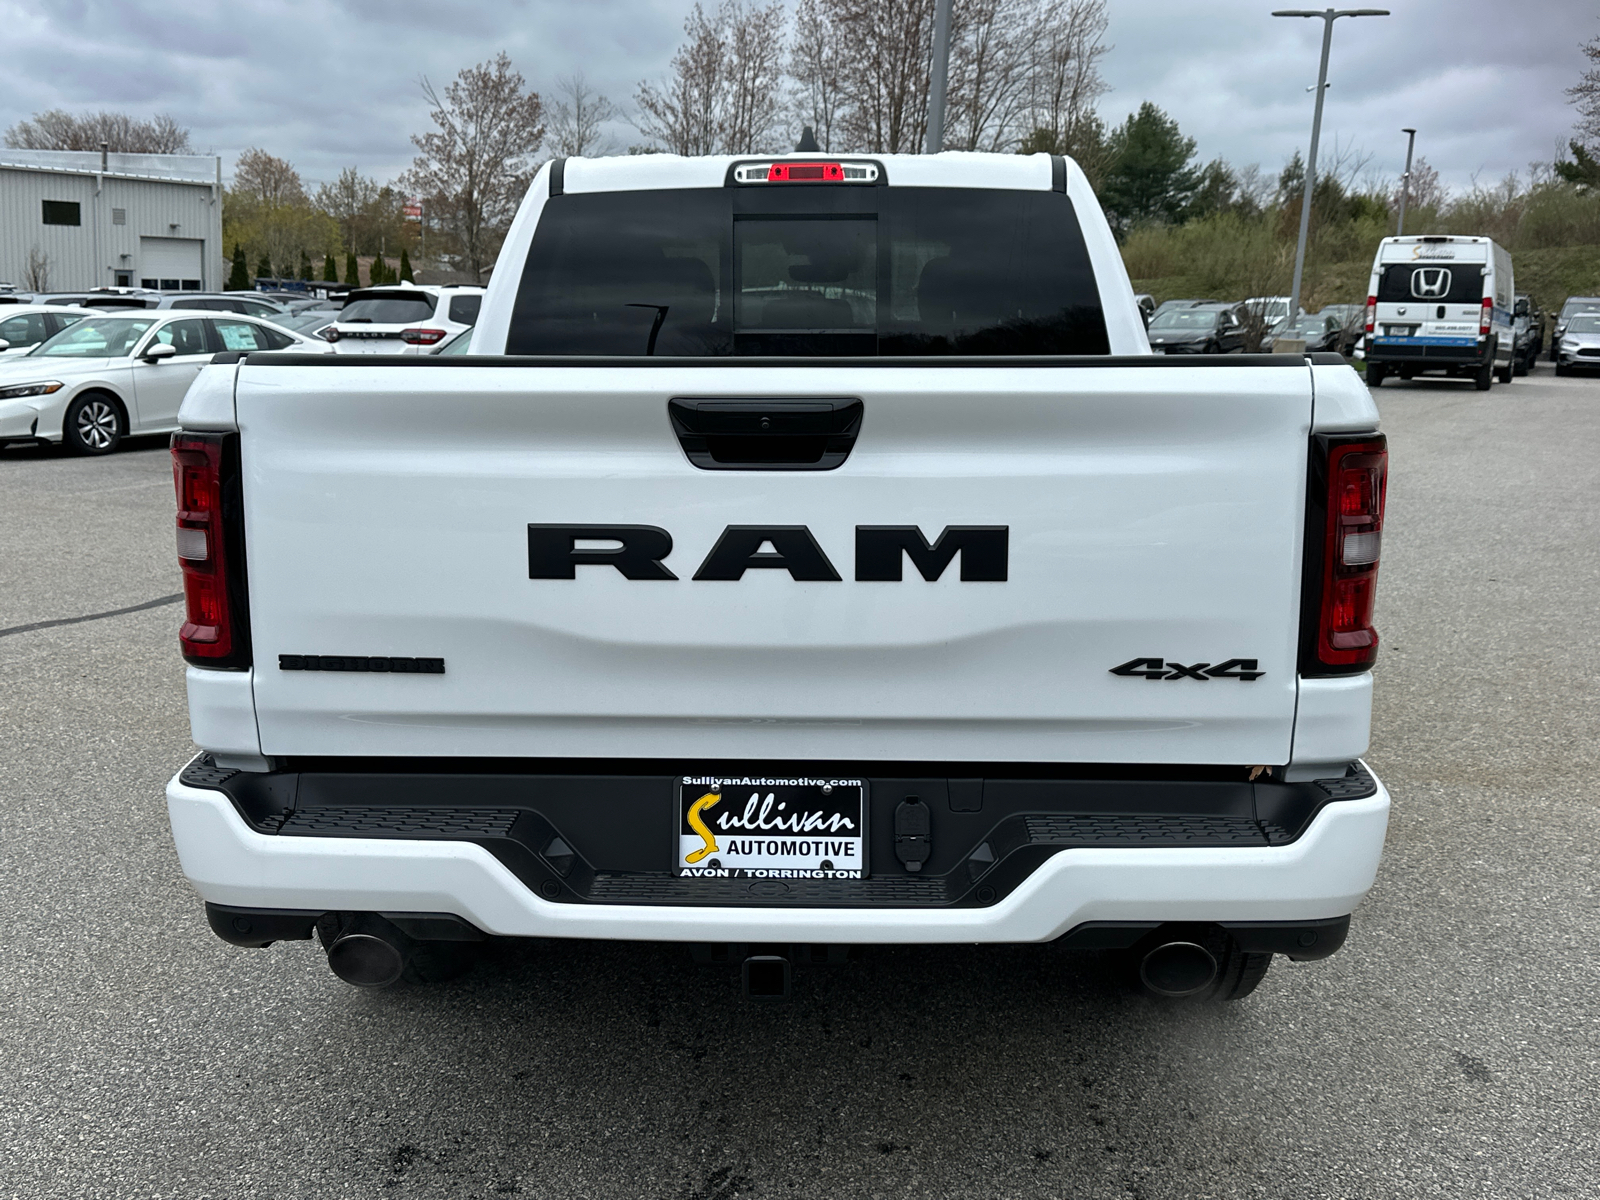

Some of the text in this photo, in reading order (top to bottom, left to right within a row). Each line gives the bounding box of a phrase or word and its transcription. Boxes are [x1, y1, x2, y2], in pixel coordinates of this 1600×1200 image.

[528, 523, 1009, 582] RAM
[1108, 657, 1267, 681] 4x4
[682, 776, 861, 787] SullivanAutomotive.com
[685, 791, 855, 864] Sullivan
[726, 840, 855, 857] AUTOMOTIVE
[680, 868, 729, 877] AVON
[744, 869, 861, 879] TORRINGTON
